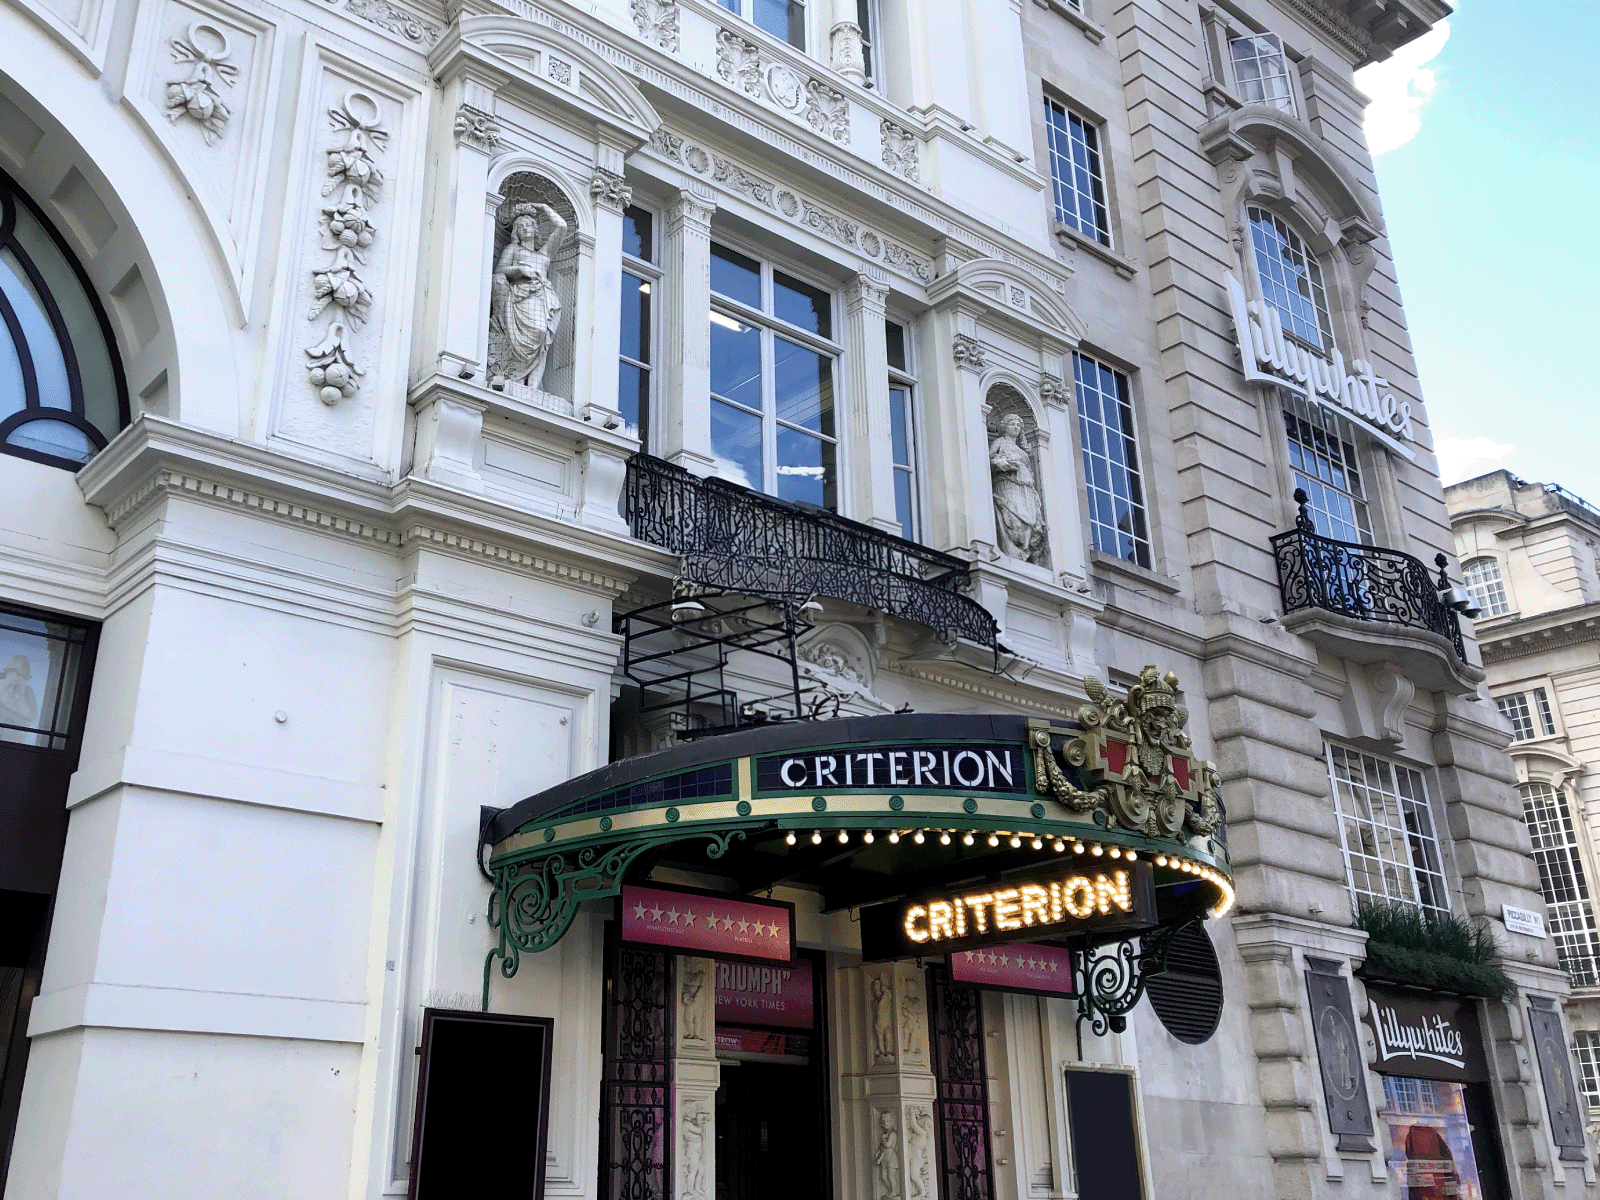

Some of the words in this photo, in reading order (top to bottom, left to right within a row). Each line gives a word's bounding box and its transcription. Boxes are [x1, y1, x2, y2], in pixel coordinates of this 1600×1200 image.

[1223, 270, 1415, 456] Lillywhites
[780, 750, 1014, 788] CRITERION
[904, 870, 1134, 943] CRITERION
[1506, 909, 1532, 923] PICCADILLY
[735, 996, 759, 1009] YORK
[761, 999, 786, 1011] TIMES
[1368, 997, 1464, 1066] Lillywhites
